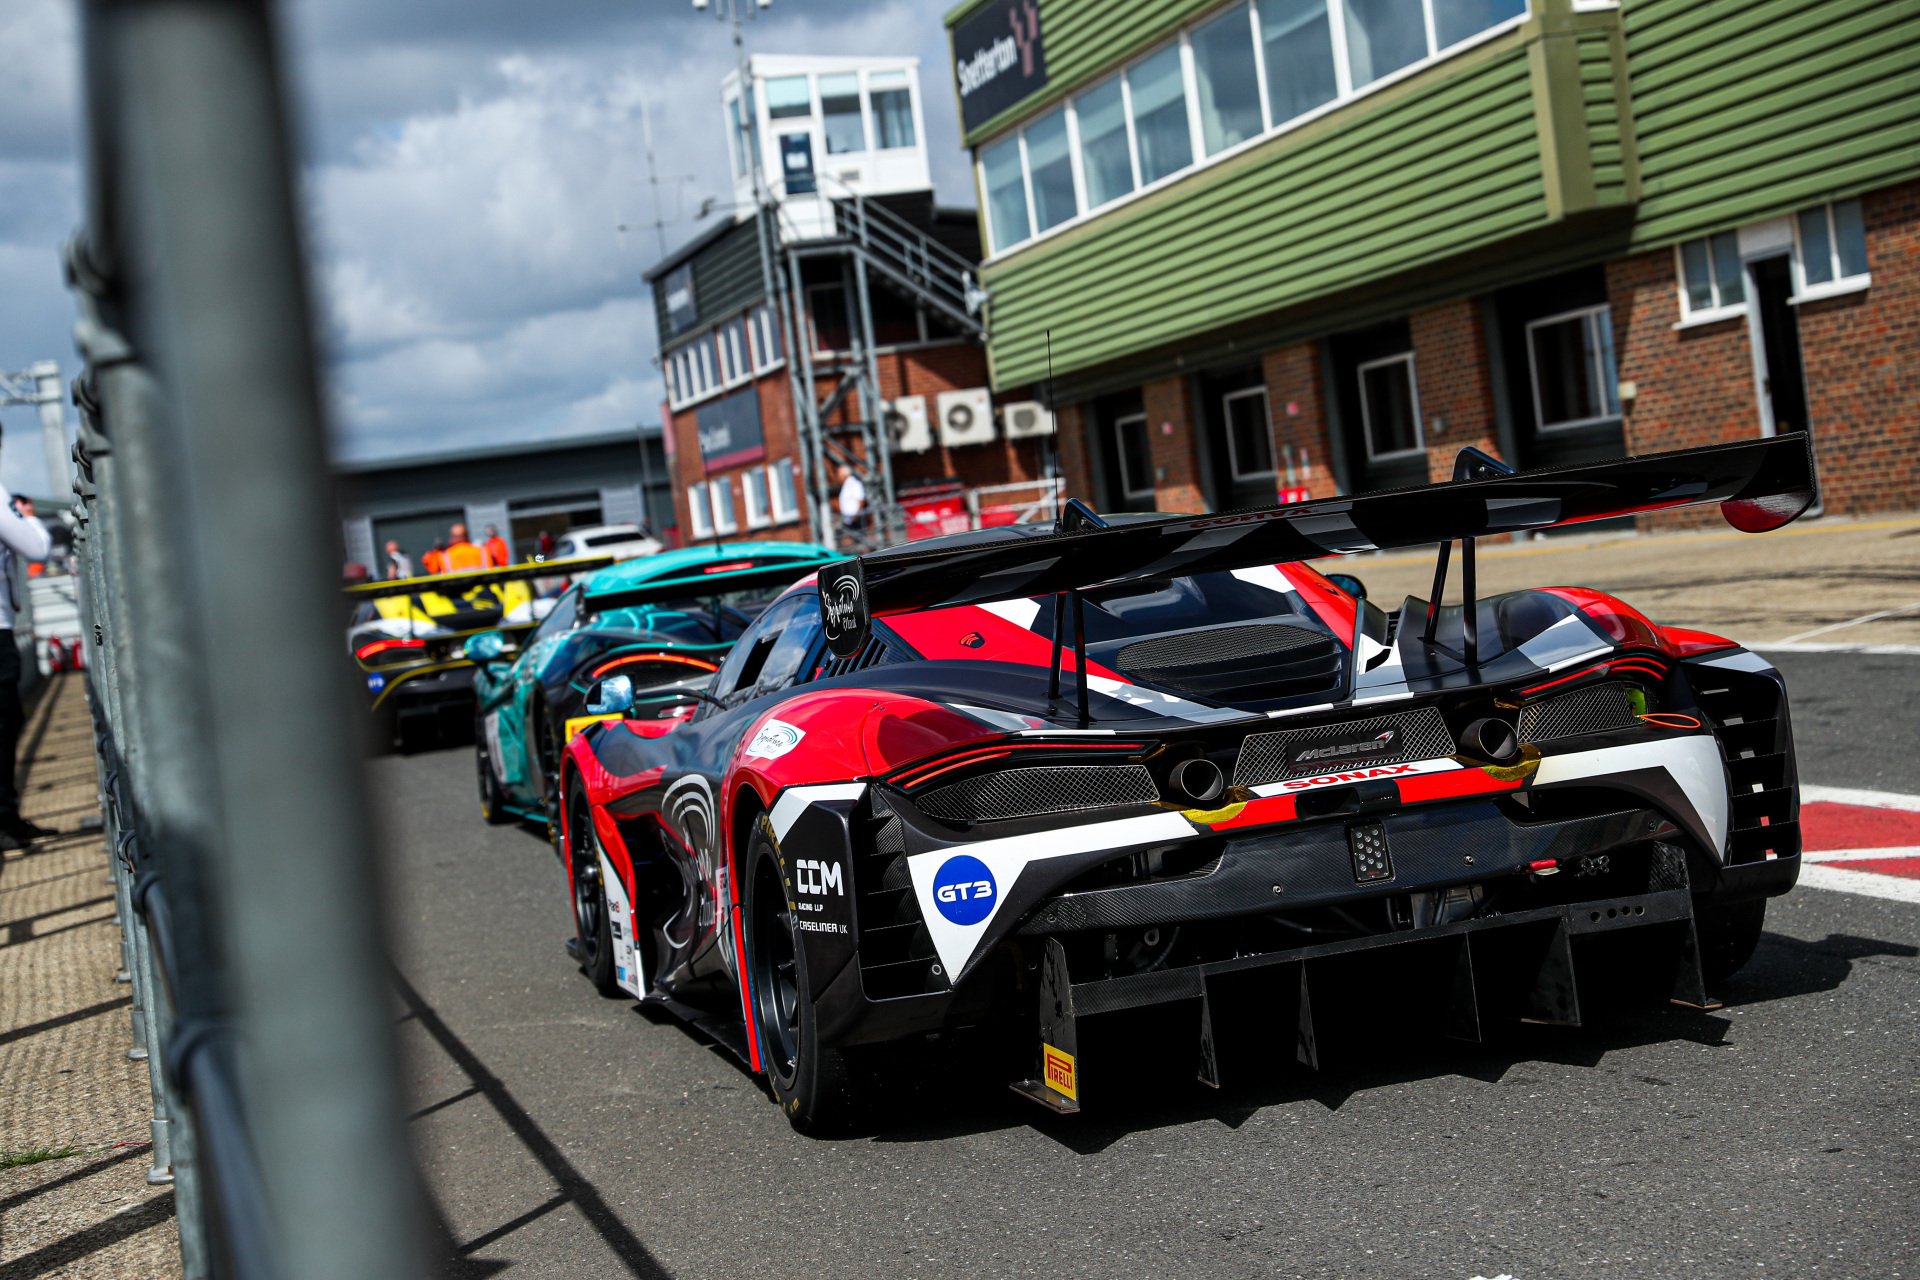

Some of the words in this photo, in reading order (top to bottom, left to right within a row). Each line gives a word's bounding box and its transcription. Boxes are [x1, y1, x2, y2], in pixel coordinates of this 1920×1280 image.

[1295, 740, 1385, 762] McLaren
[1283, 764, 1421, 789] SONAX
[796, 859, 844, 896] CCM
[937, 880, 993, 903] GT3
[798, 902, 813, 912] RACING
[814, 903, 824, 912] LLP
[799, 920, 838, 933] CASELINER
[839, 924, 848, 934] UK
[1047, 1052, 1073, 1090] PIRELLI
